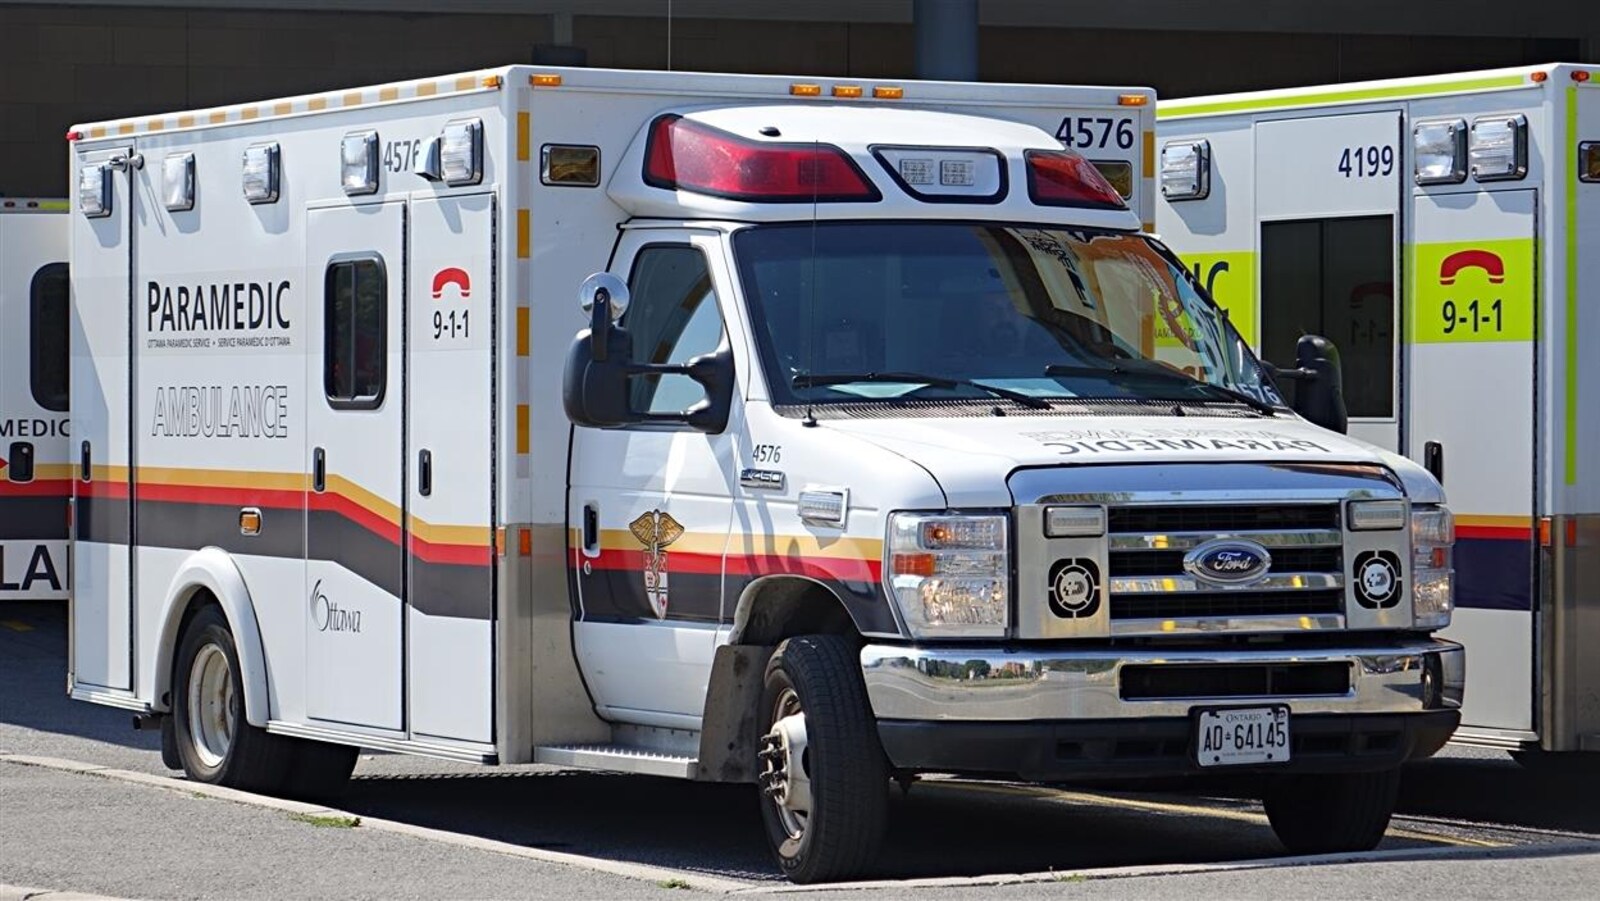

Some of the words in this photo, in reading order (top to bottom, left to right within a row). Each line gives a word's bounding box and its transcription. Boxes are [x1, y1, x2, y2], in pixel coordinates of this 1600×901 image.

[1055, 117, 1134, 149] 4576
[1338, 145, 1394, 178] 4199
[147, 280, 291, 332] PARAMEDIC
[1442, 299, 1502, 334] 9-1-1
[433, 309, 469, 339] 9-1-1
[152, 386, 288, 438] AMBULANCE
[752, 444, 782, 463] 4576
[1213, 551, 1251, 570] Ford
[310, 579, 361, 633] Ottawa
[1226, 713, 1262, 722] ONTARIO
